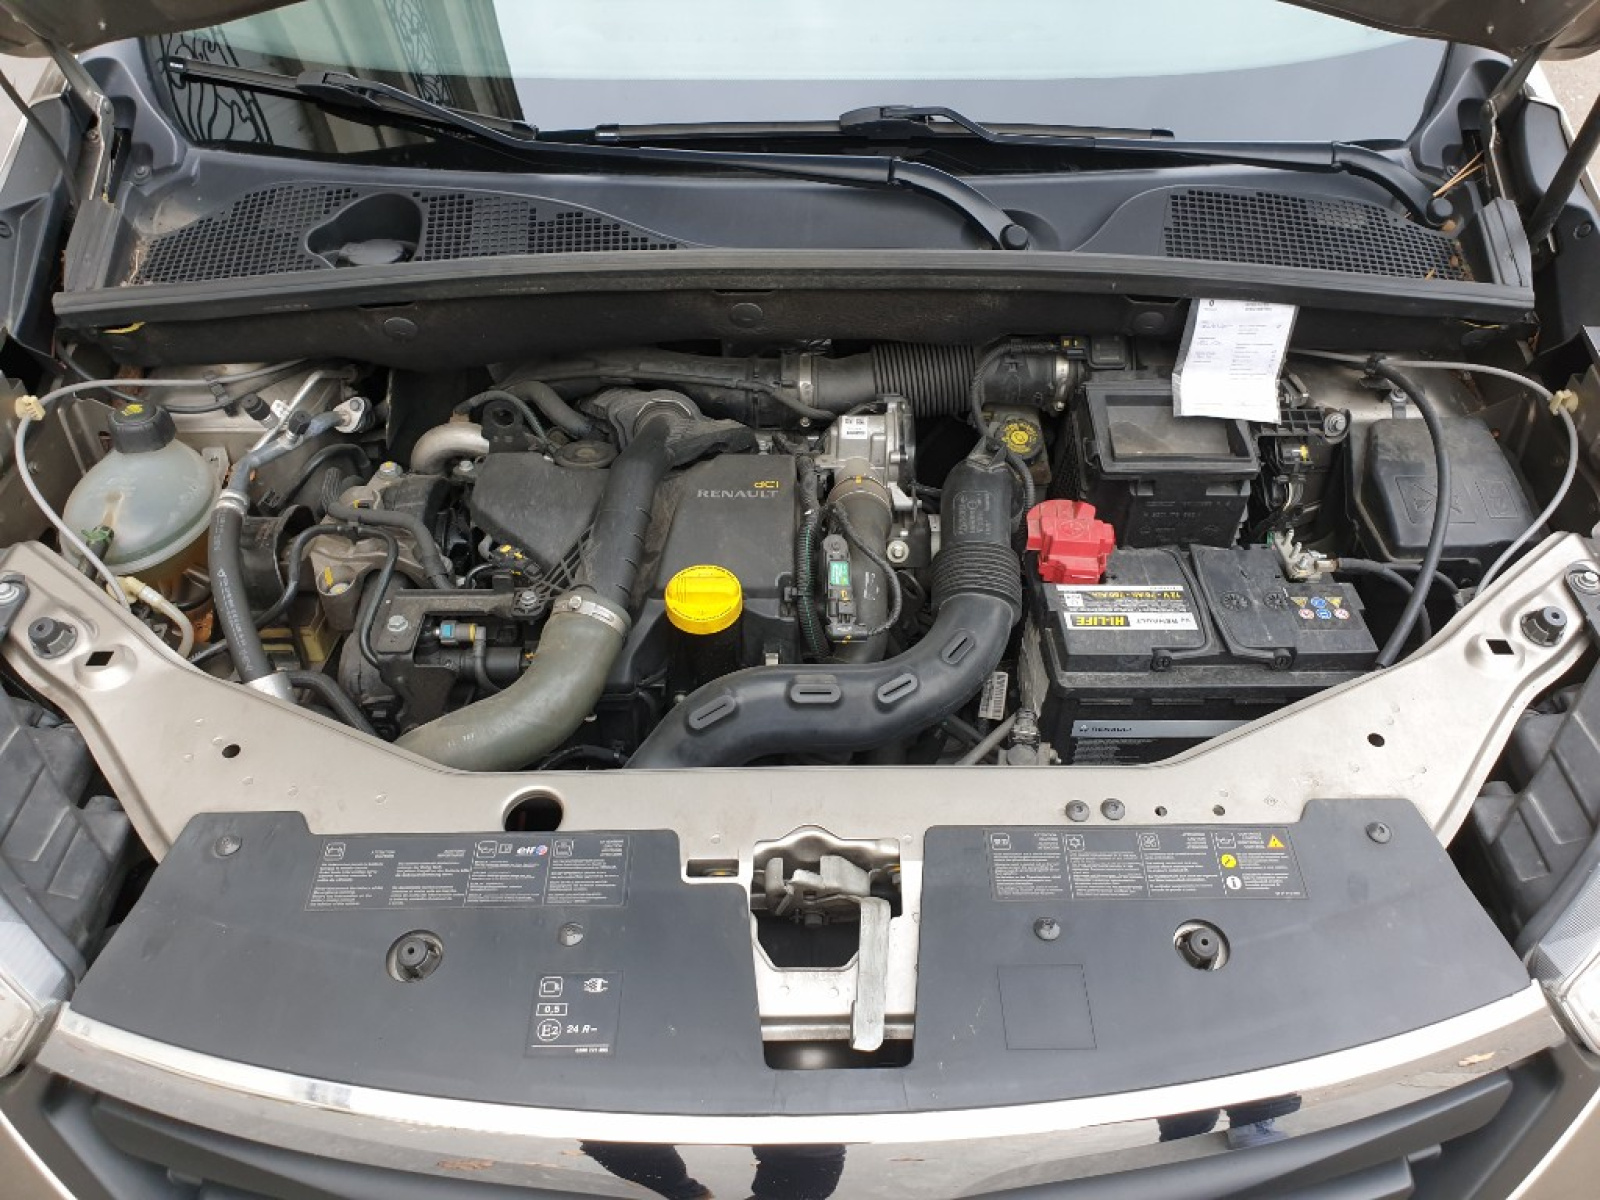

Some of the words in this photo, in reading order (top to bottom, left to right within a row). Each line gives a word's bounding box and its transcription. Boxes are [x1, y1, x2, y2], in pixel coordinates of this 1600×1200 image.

[697, 489, 779, 498] RENAULT
[1076, 616, 1125, 626] HI-LIFE
[566, 1024, 579, 1034] 24
